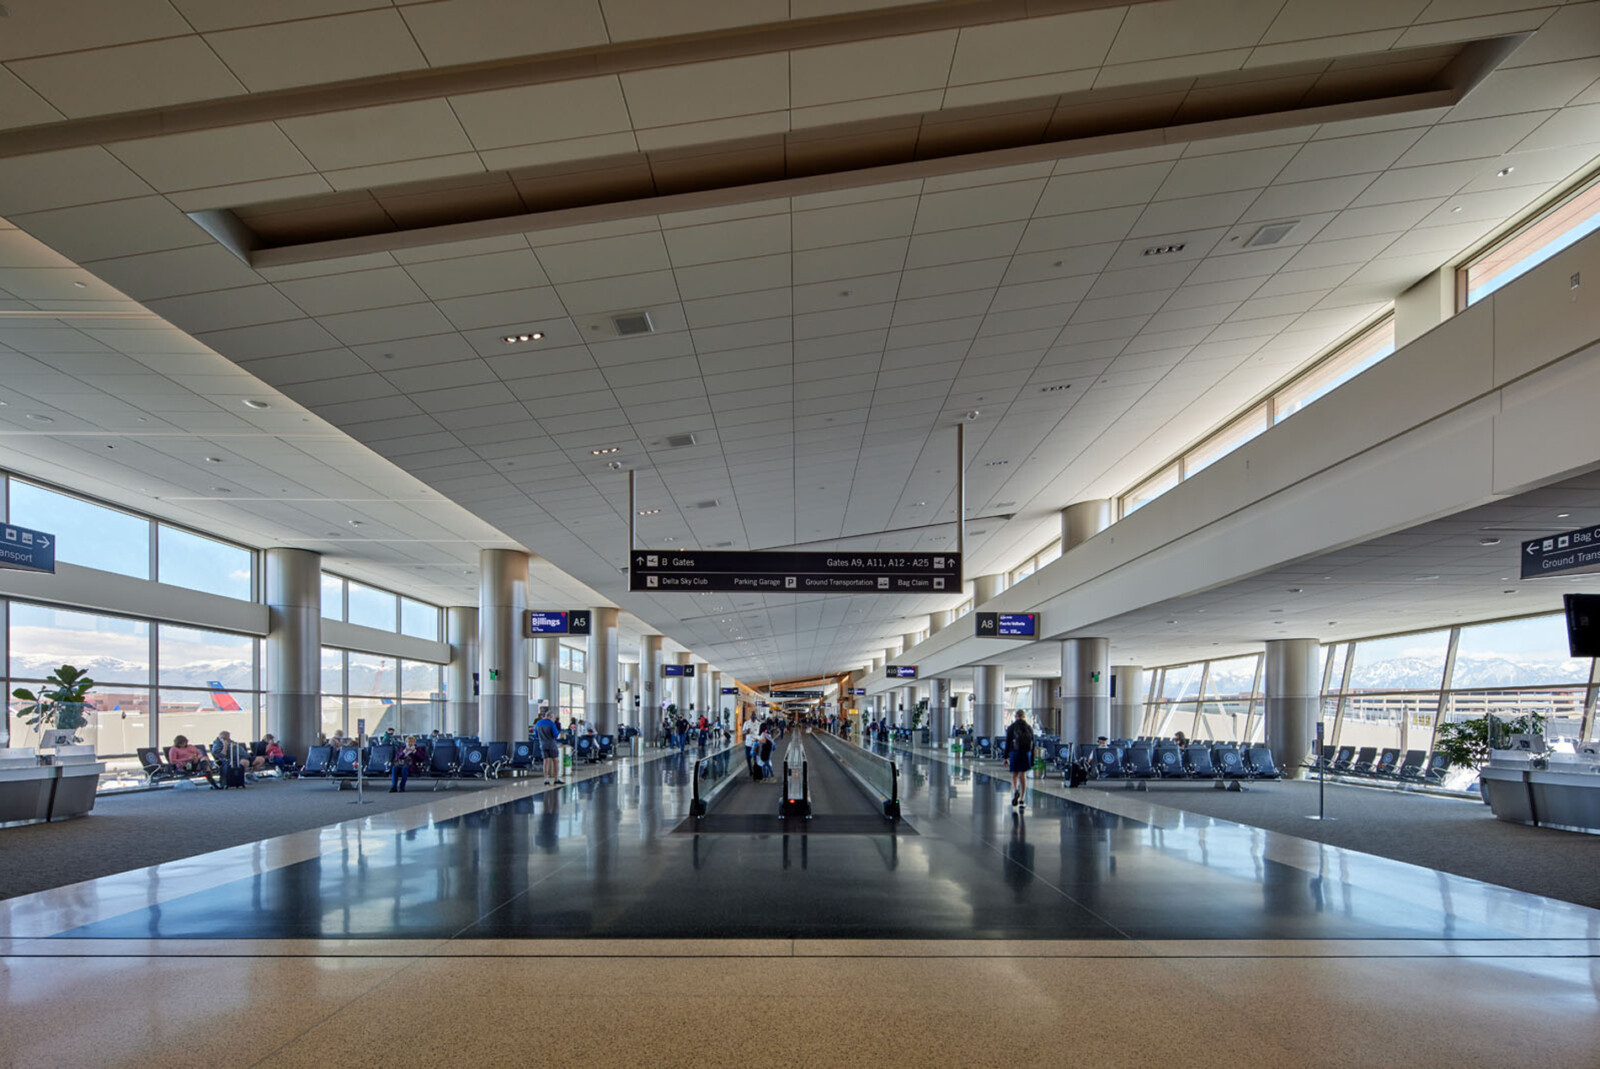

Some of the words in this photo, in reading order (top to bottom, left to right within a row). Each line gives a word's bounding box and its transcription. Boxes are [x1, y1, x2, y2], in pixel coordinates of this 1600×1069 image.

[1573, 532, 1592, 543] Bag
[661, 558, 668, 566] B
[672, 557, 695, 567] Gates
[826, 558, 849, 567] Gates
[850, 558, 865, 568] A9,
[866, 558, 886, 568] A11,
[888, 558, 905, 567] A12
[912, 558, 929, 567] A25
[1542, 555, 1574, 569] Ground
[662, 577, 679, 585] Delta
[680, 577, 692, 587] Sky
[693, 577, 708, 585] Club
[734, 577, 757, 587] Parking
[758, 578, 781, 587] Garage
[805, 578, 828, 586] Ground
[829, 578, 874, 587] Transportation
[897, 579, 911, 588] Bag
[911, 579, 929, 587] Claim
[532, 617, 561, 627] Billings
[573, 617, 586, 627] A5
[981, 619, 994, 629] A8
